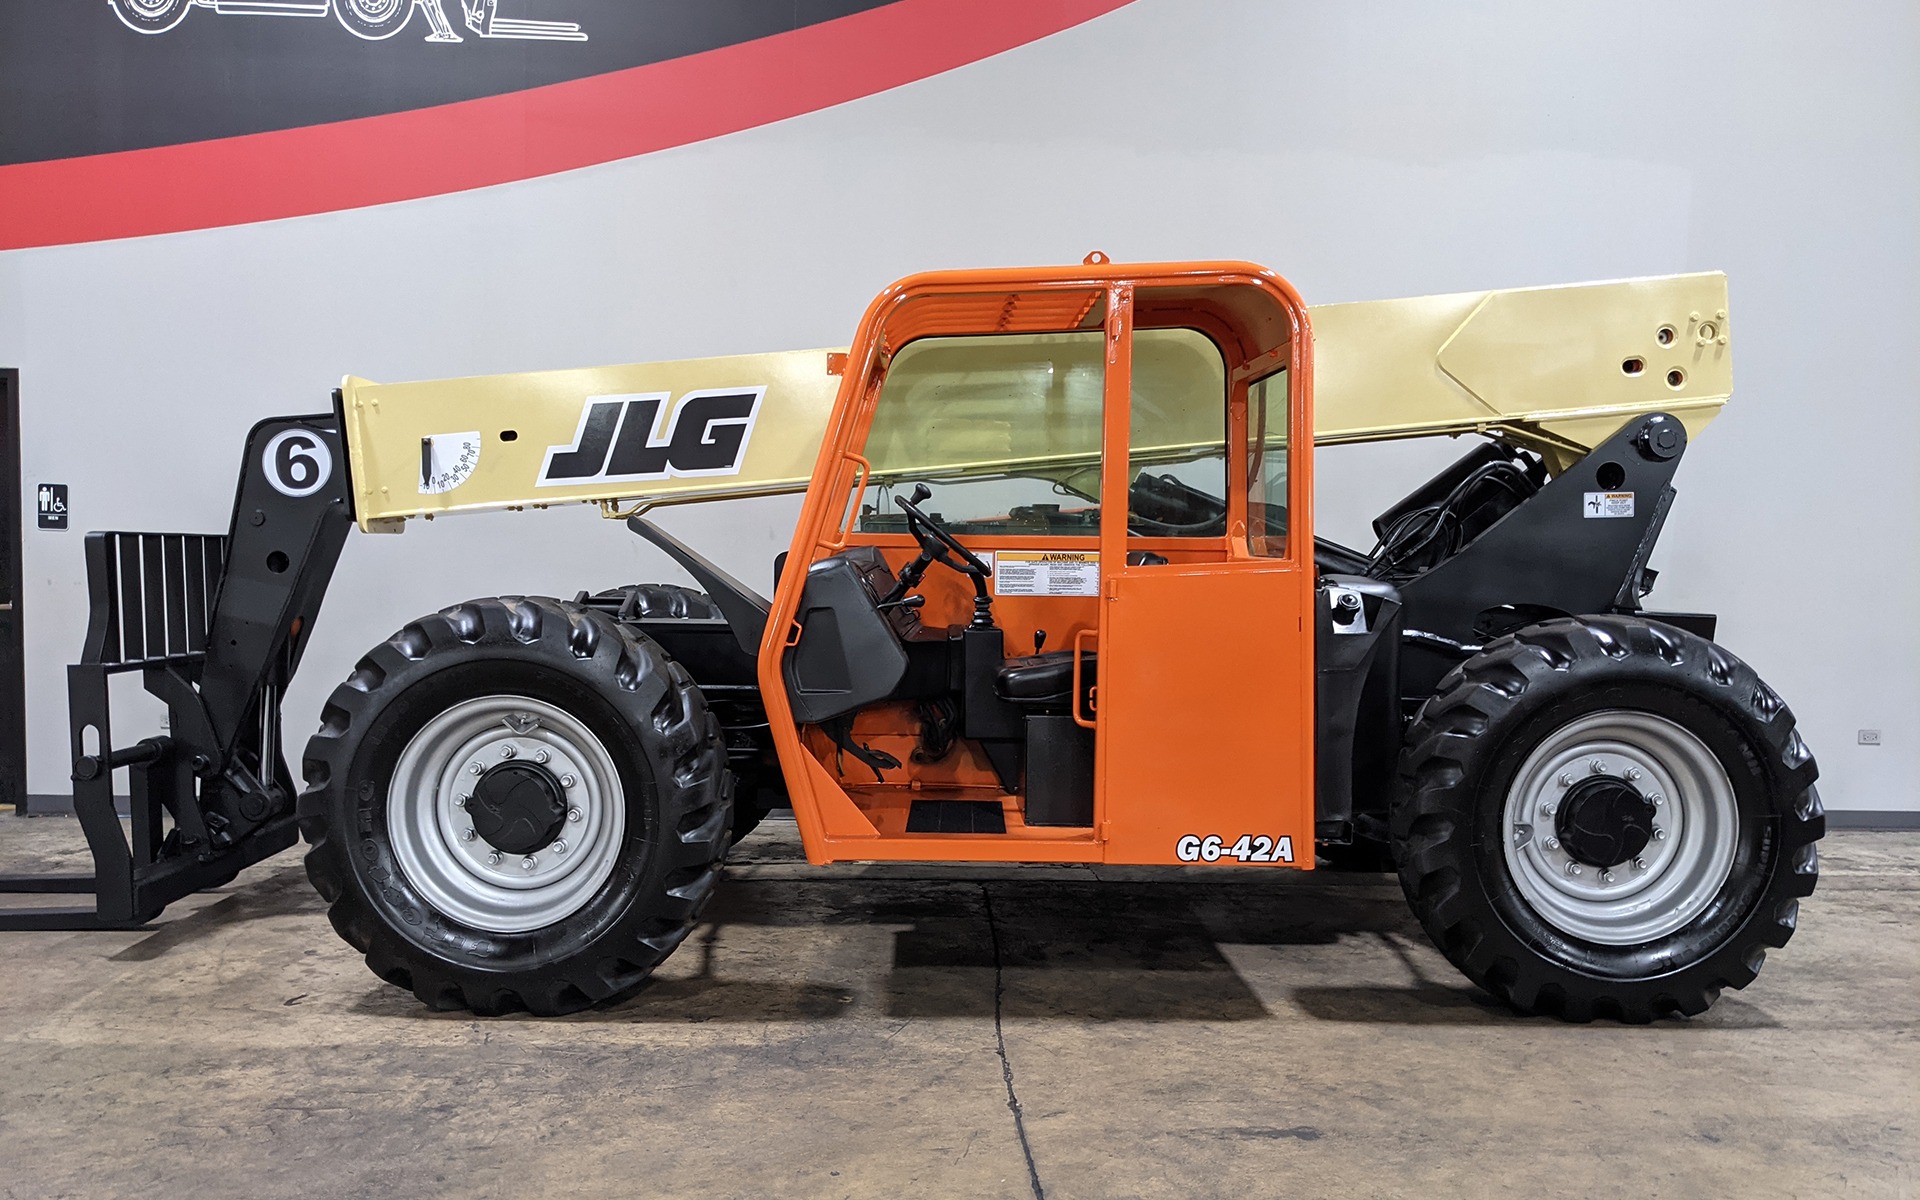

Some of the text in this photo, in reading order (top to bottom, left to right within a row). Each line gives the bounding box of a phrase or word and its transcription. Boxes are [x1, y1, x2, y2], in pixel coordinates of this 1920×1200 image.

[545, 393, 757, 479] JLG
[462, 442, 471, 450] 80
[275, 436, 320, 490] 6
[461, 463, 469, 472] 50
[453, 465, 461, 473] 40
[441, 473, 450, 482] 20
[450, 474, 459, 483] 30
[437, 480, 445, 489] 10
[1049, 553, 1085, 561] WARNING
[1176, 834, 1294, 862] G6-42A
